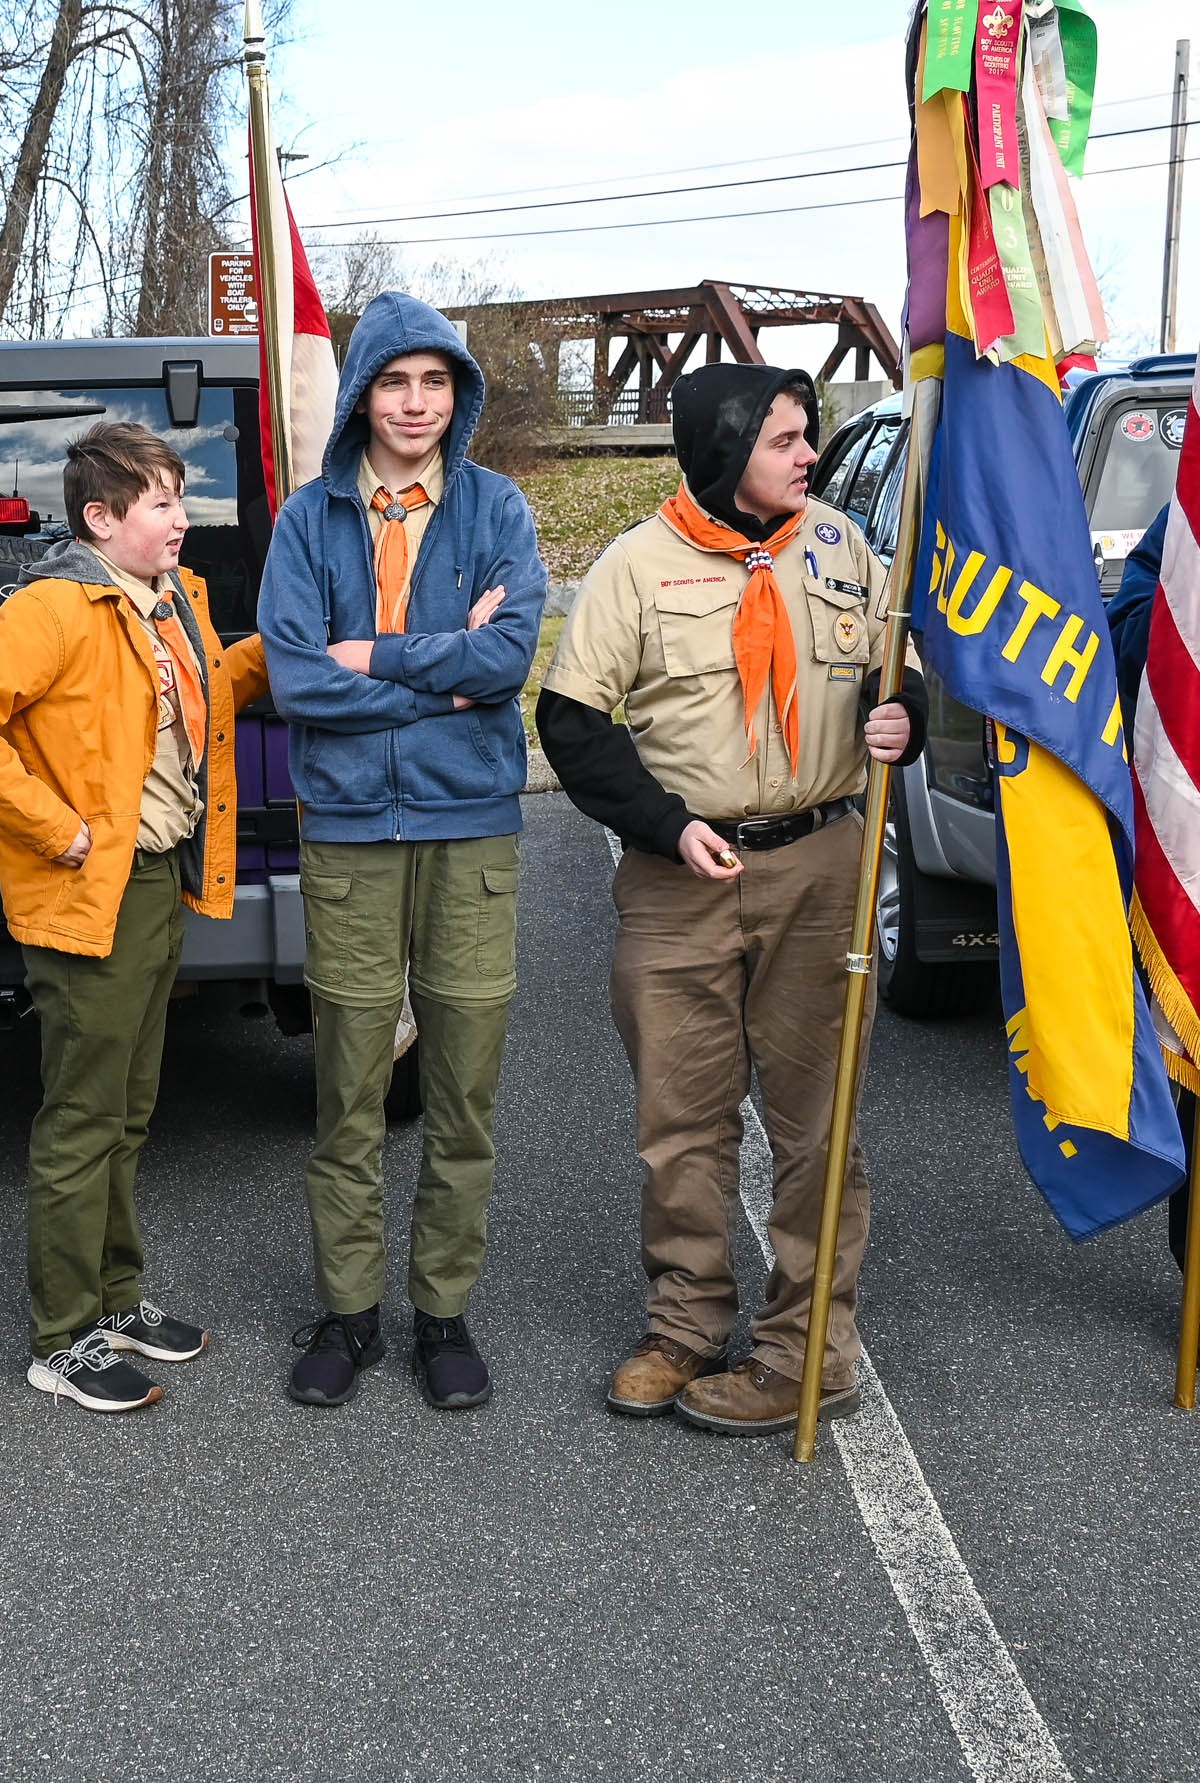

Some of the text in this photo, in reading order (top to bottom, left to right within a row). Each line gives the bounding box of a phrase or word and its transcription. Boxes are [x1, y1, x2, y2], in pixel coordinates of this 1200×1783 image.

[982, 54, 1004, 62] FRIENDS
[984, 61, 1009, 69] SCOUTING
[991, 103, 1006, 169] PARTICIPANT UNIT
[971, 262, 999, 285] QUALITY
[979, 274, 994, 288] UNIT
[976, 279, 1000, 297] AWARD
[220, 296, 253, 304] TRAILERS
[660, 580, 672, 588] BOY
[673, 578, 695, 586] SCOUTS
